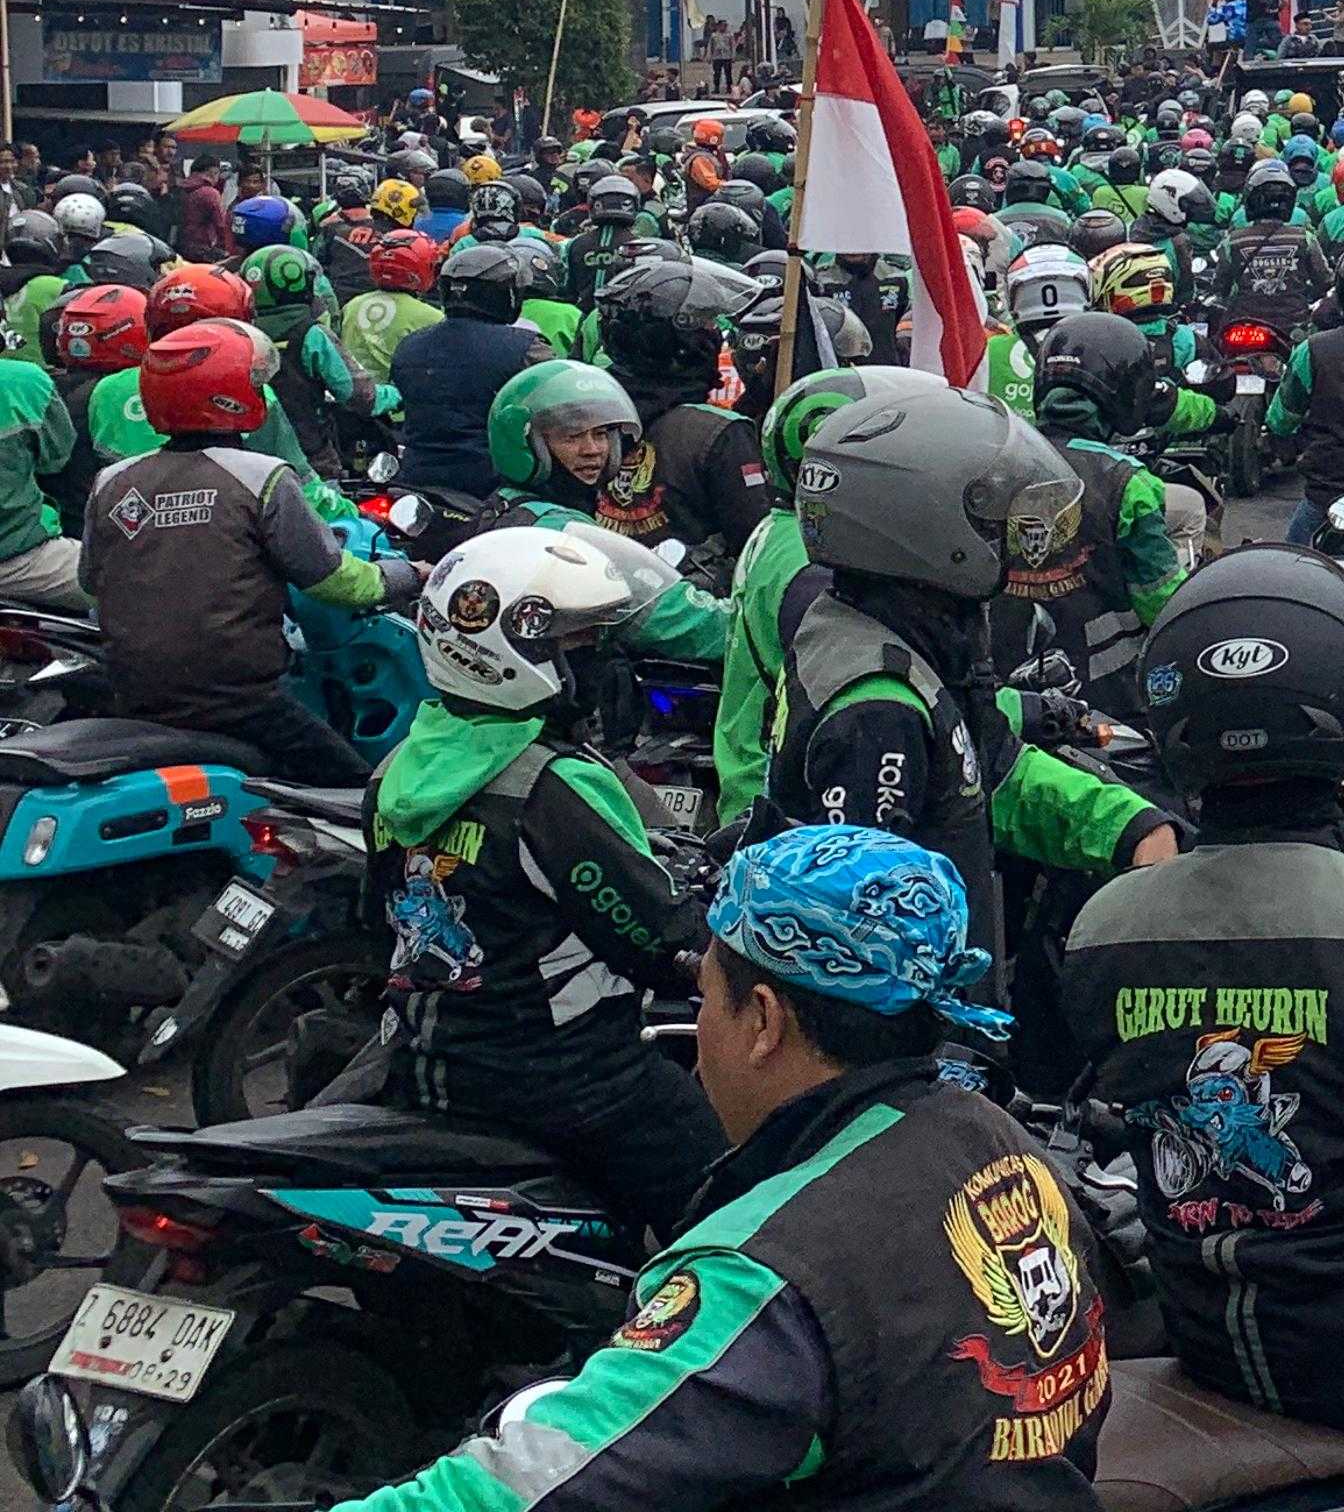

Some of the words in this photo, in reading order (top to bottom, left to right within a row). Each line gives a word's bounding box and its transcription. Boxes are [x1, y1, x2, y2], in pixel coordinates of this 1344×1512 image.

[1004, 380, 1034, 403] goj
[155, 490, 216, 509] PATRIOT
[155, 508, 211, 526] LEGEND
[443, 644, 494, 679] INK
[1225, 731, 1260, 748] DOT
[590, 886, 665, 956] gojek
[1116, 988, 1207, 1043] GARUT
[1215, 987, 1329, 1046] HEURIN
[74, 1293, 98, 1329] Z
[100, 1298, 160, 1339] 6884
[169, 1309, 226, 1355] DAK
[1035, 1353, 1088, 1402] 2021
